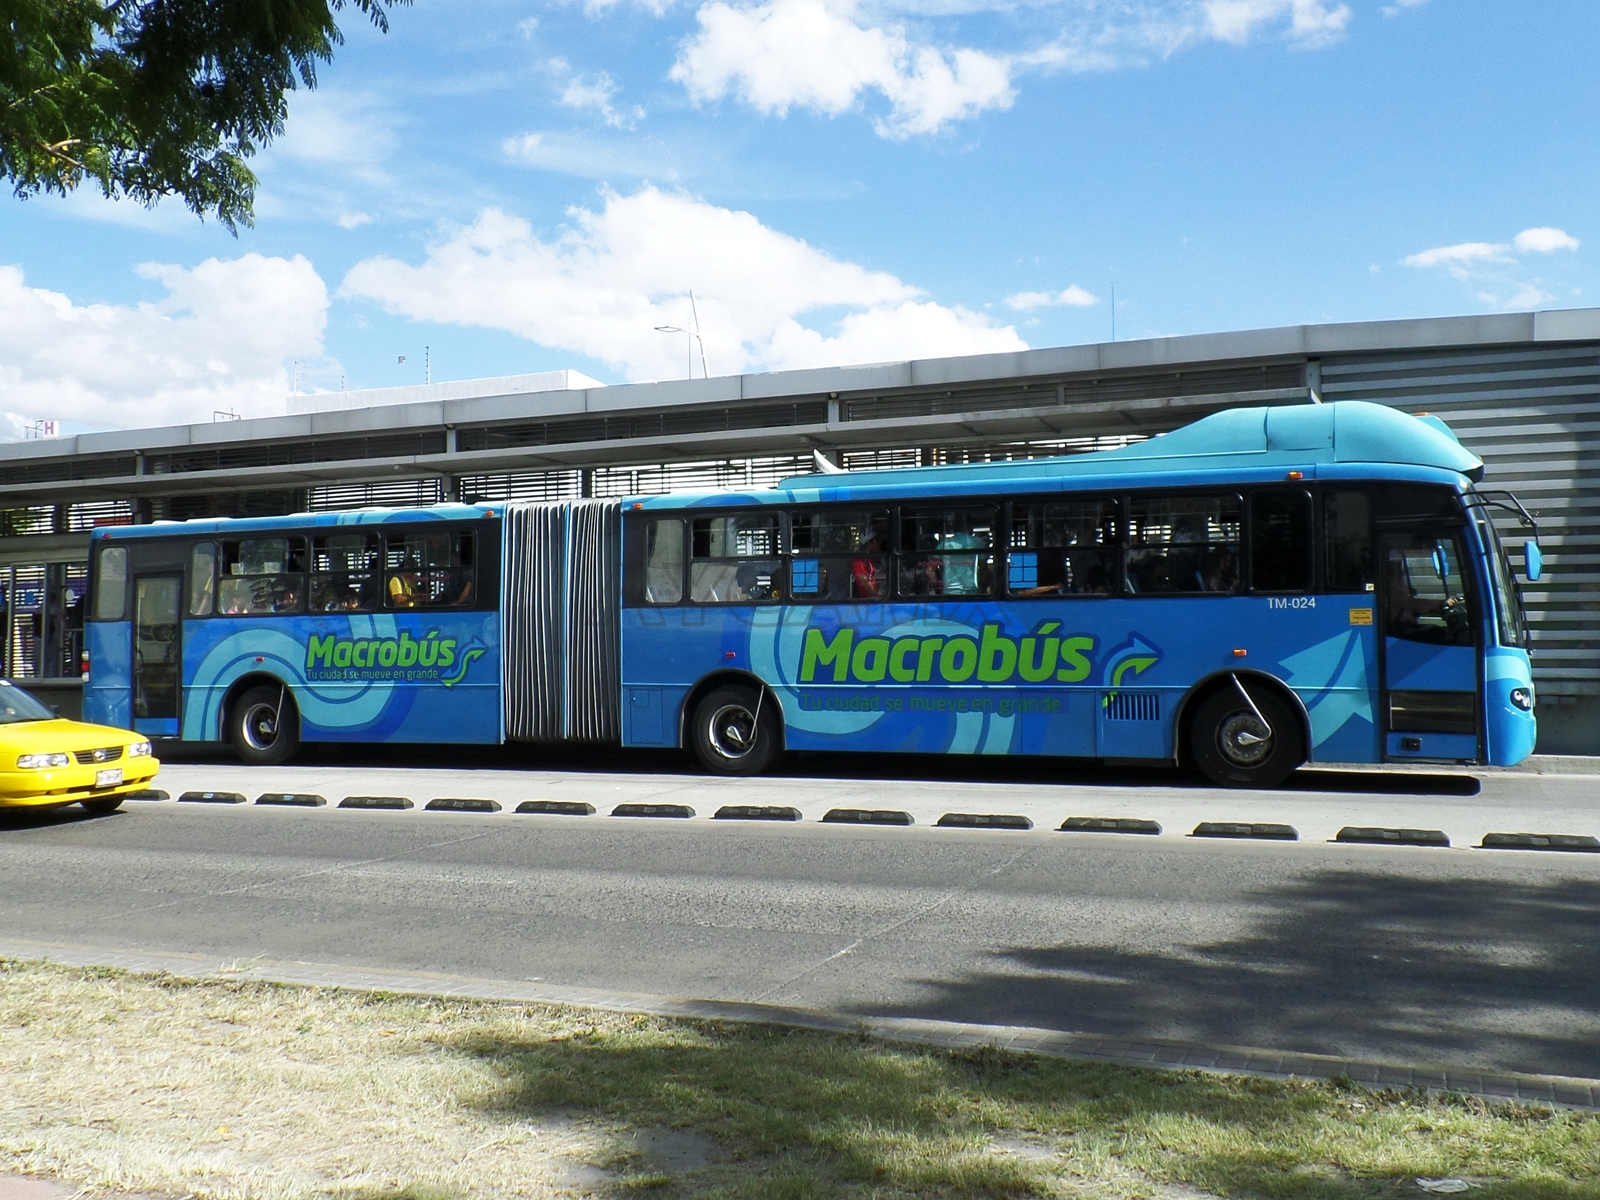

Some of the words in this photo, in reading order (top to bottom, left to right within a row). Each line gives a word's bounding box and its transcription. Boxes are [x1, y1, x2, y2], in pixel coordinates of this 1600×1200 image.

[44, 421, 54, 435] H
[1266, 597, 1317, 609] TM-024
[306, 630, 456, 668] Macrobús
[800, 622, 1094, 682] Macrobús
[307, 669, 318, 679] Tu
[319, 669, 347, 679] ciudad
[349, 671, 360, 679] se
[361, 670, 391, 679] mueve
[393, 670, 405, 679] en
[407, 668, 438, 681] grande
[801, 693, 821, 710] Tu
[825, 693, 880, 710] ciudad
[885, 698, 903, 711] se
[909, 697, 967, 712] mueve
[971, 699, 993, 712] en
[1000, 696, 1062, 715] grande
